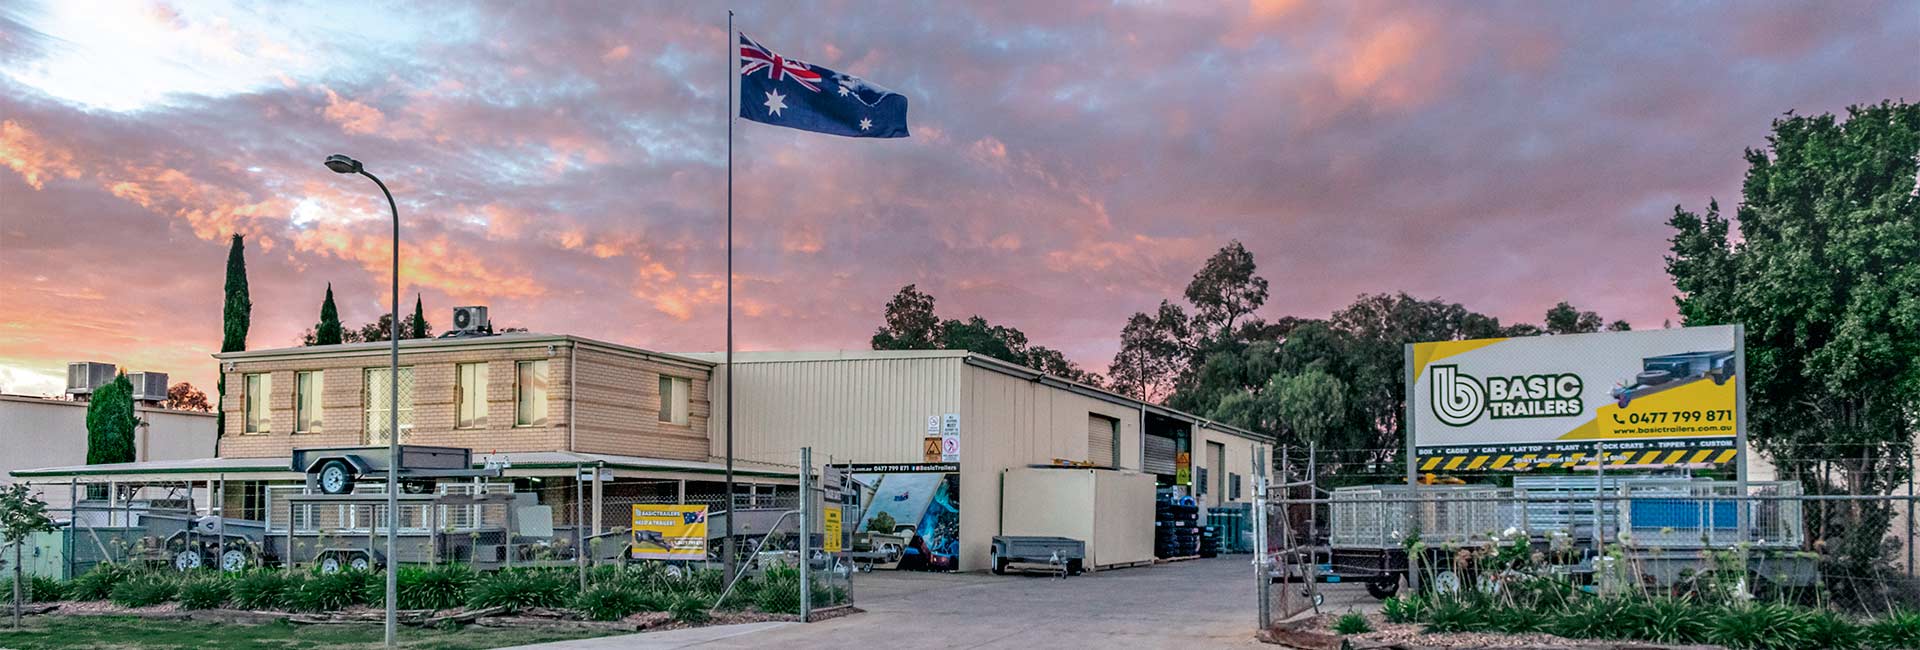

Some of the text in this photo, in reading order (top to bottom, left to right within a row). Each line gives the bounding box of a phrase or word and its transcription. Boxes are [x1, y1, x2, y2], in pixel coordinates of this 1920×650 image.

[1488, 375, 1581, 401] BASIC
[1489, 399, 1581, 417] TRAILERS
[1629, 410, 1732, 424] 0477 799 871
[1614, 425, 1732, 434] www.basictrailers.com.au
